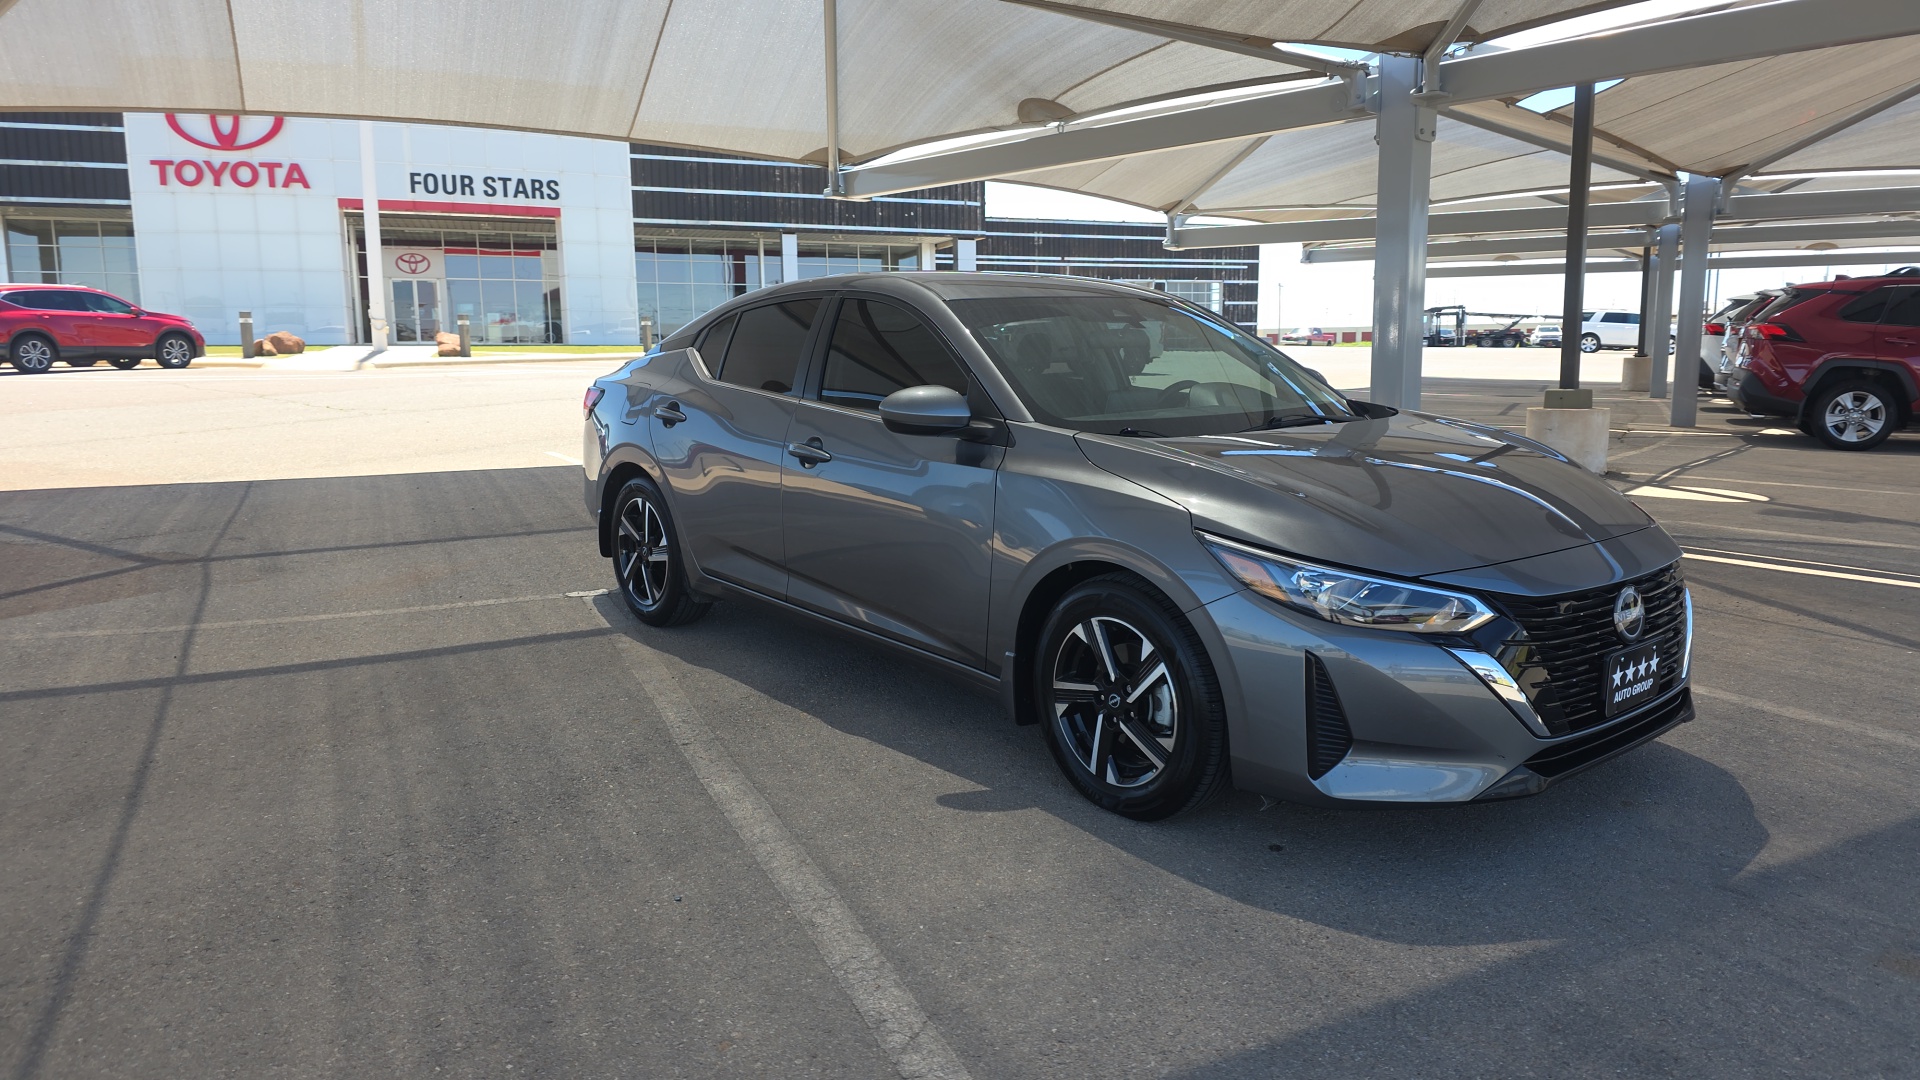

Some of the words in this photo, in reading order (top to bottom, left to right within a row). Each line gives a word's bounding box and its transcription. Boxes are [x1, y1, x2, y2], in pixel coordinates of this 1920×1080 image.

[149, 159, 311, 189] TOYOTA
[409, 172, 475, 195] FOUR
[483, 176, 560, 200] STARS
[1613, 686, 1631, 703] AUTO
[1632, 678, 1653, 695] GROUP
